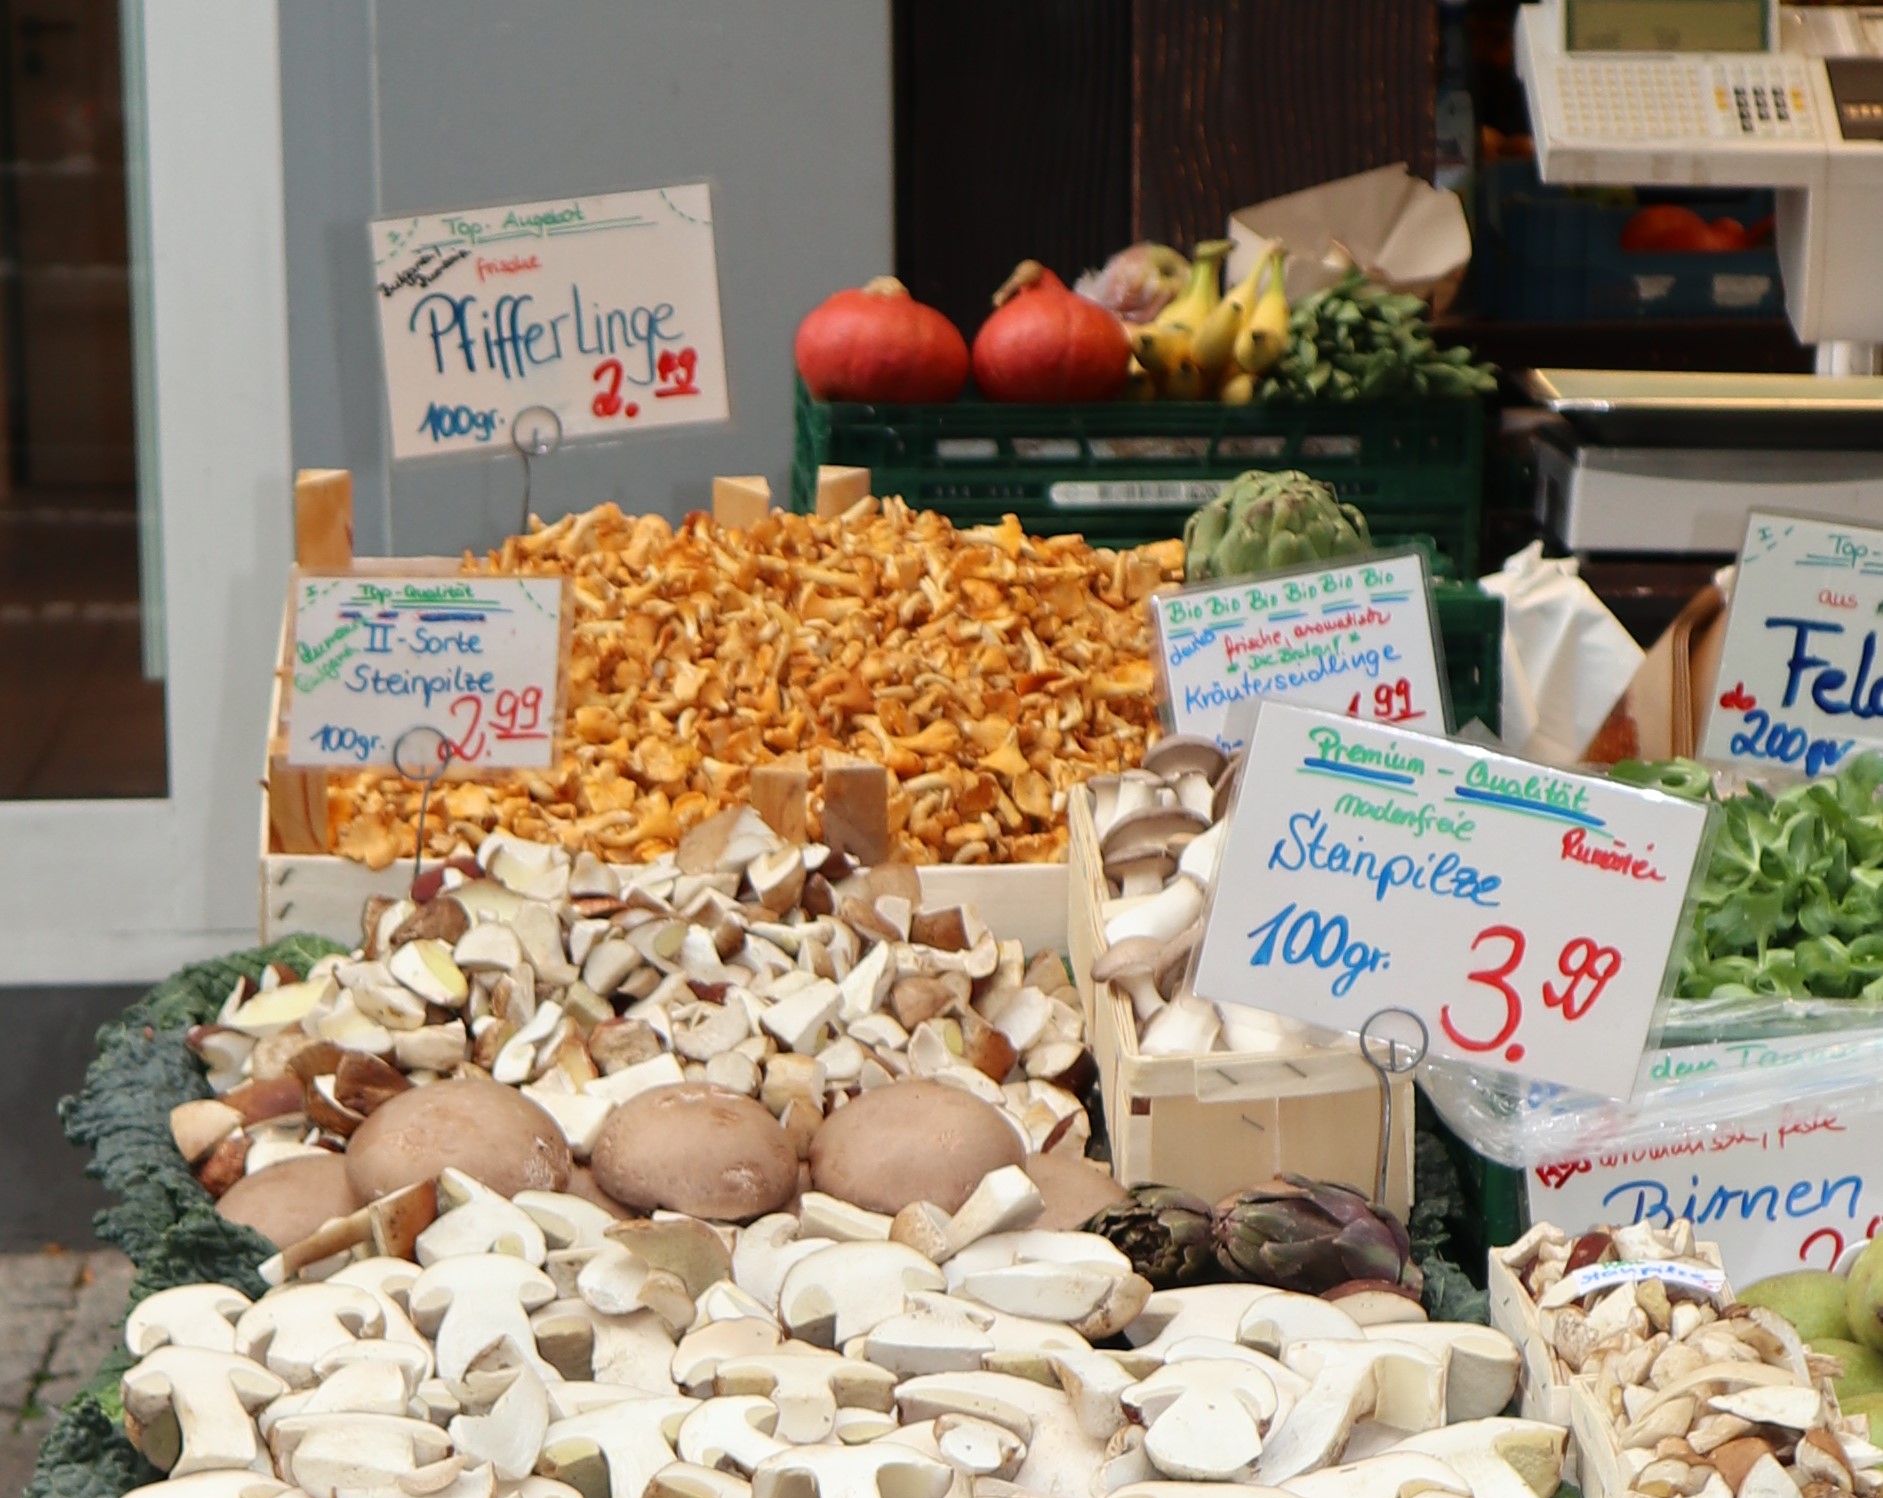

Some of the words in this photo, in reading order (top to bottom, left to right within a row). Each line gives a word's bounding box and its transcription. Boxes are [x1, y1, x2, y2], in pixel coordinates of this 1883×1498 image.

[1166, 601, 1202, 624] Bio
[1205, 596, 1241, 617] Bio
[1245, 589, 1278, 611] Bio
[1282, 581, 1318, 602] Bio
[1318, 573, 1354, 593] Bio
[1359, 567, 1394, 587] Bio
[1818, 589, 1859, 610] aus
[344, 663, 496, 709] Steinpilze
[1308, 726, 1425, 776] Premium
[1465, 759, 1590, 815] Qualität
[1268, 809, 1502, 907] Steinpilze
[1247, 902, 1391, 998] 100gr.
[1440, 924, 1623, 1063] 3.99
[1602, 1174, 1864, 1231] Birnen
